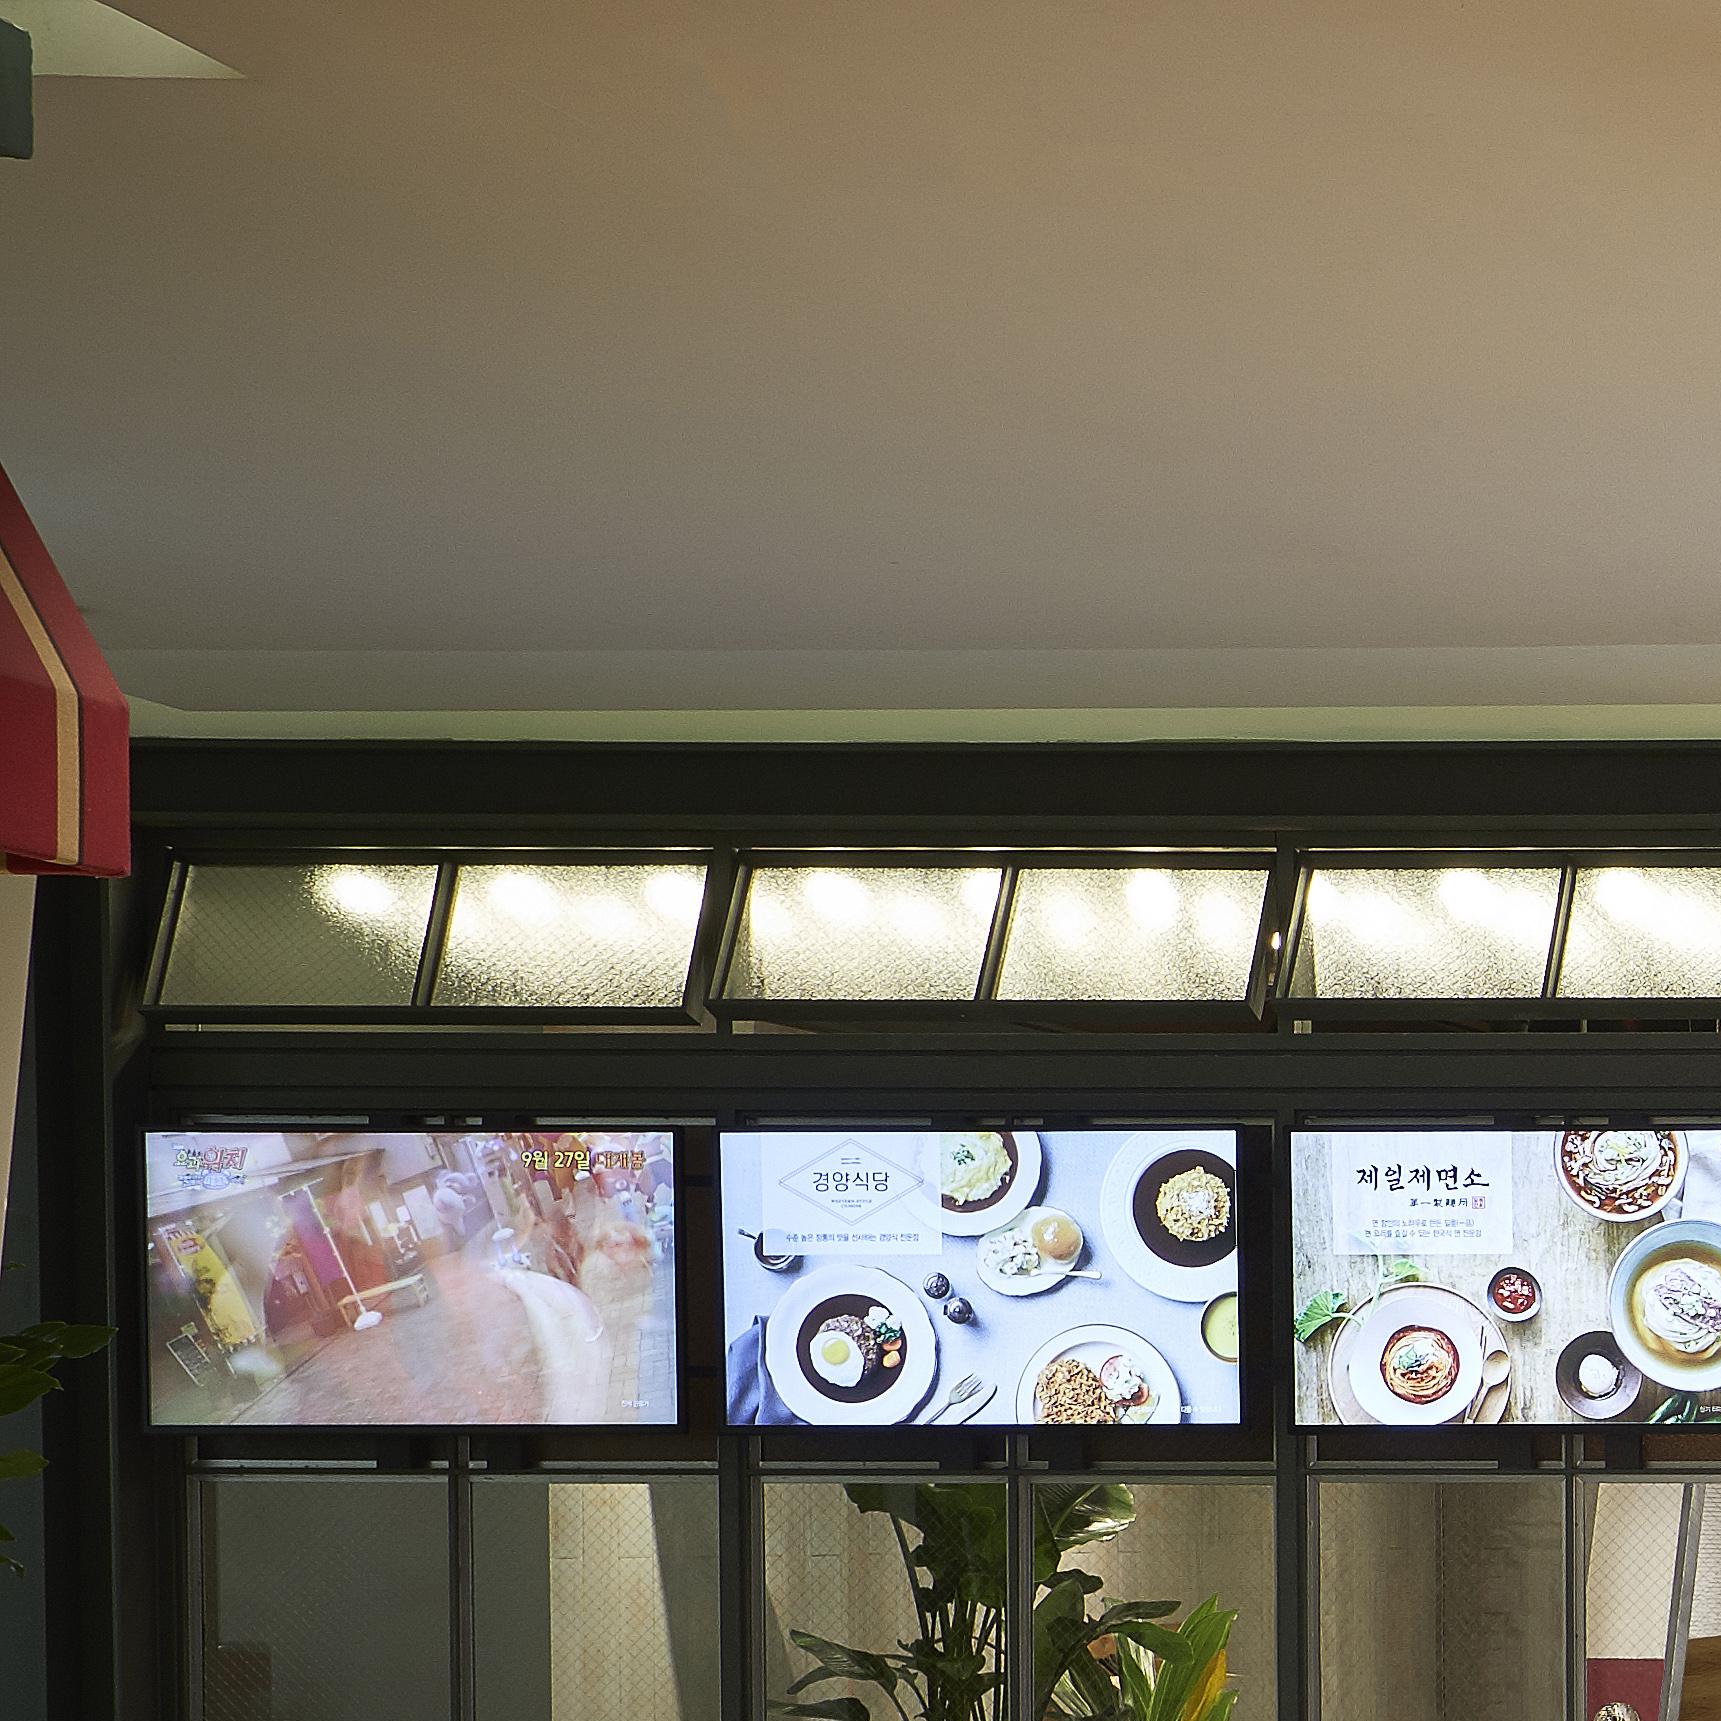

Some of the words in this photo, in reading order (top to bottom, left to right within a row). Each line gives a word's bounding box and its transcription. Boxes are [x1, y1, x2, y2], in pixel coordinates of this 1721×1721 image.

[521, 1151, 548, 1170] 9월
[554, 1151, 591, 1170] 27일
[812, 1171, 890, 1192] 경양식당
[1356, 1163, 1490, 1192] 제일제면소
